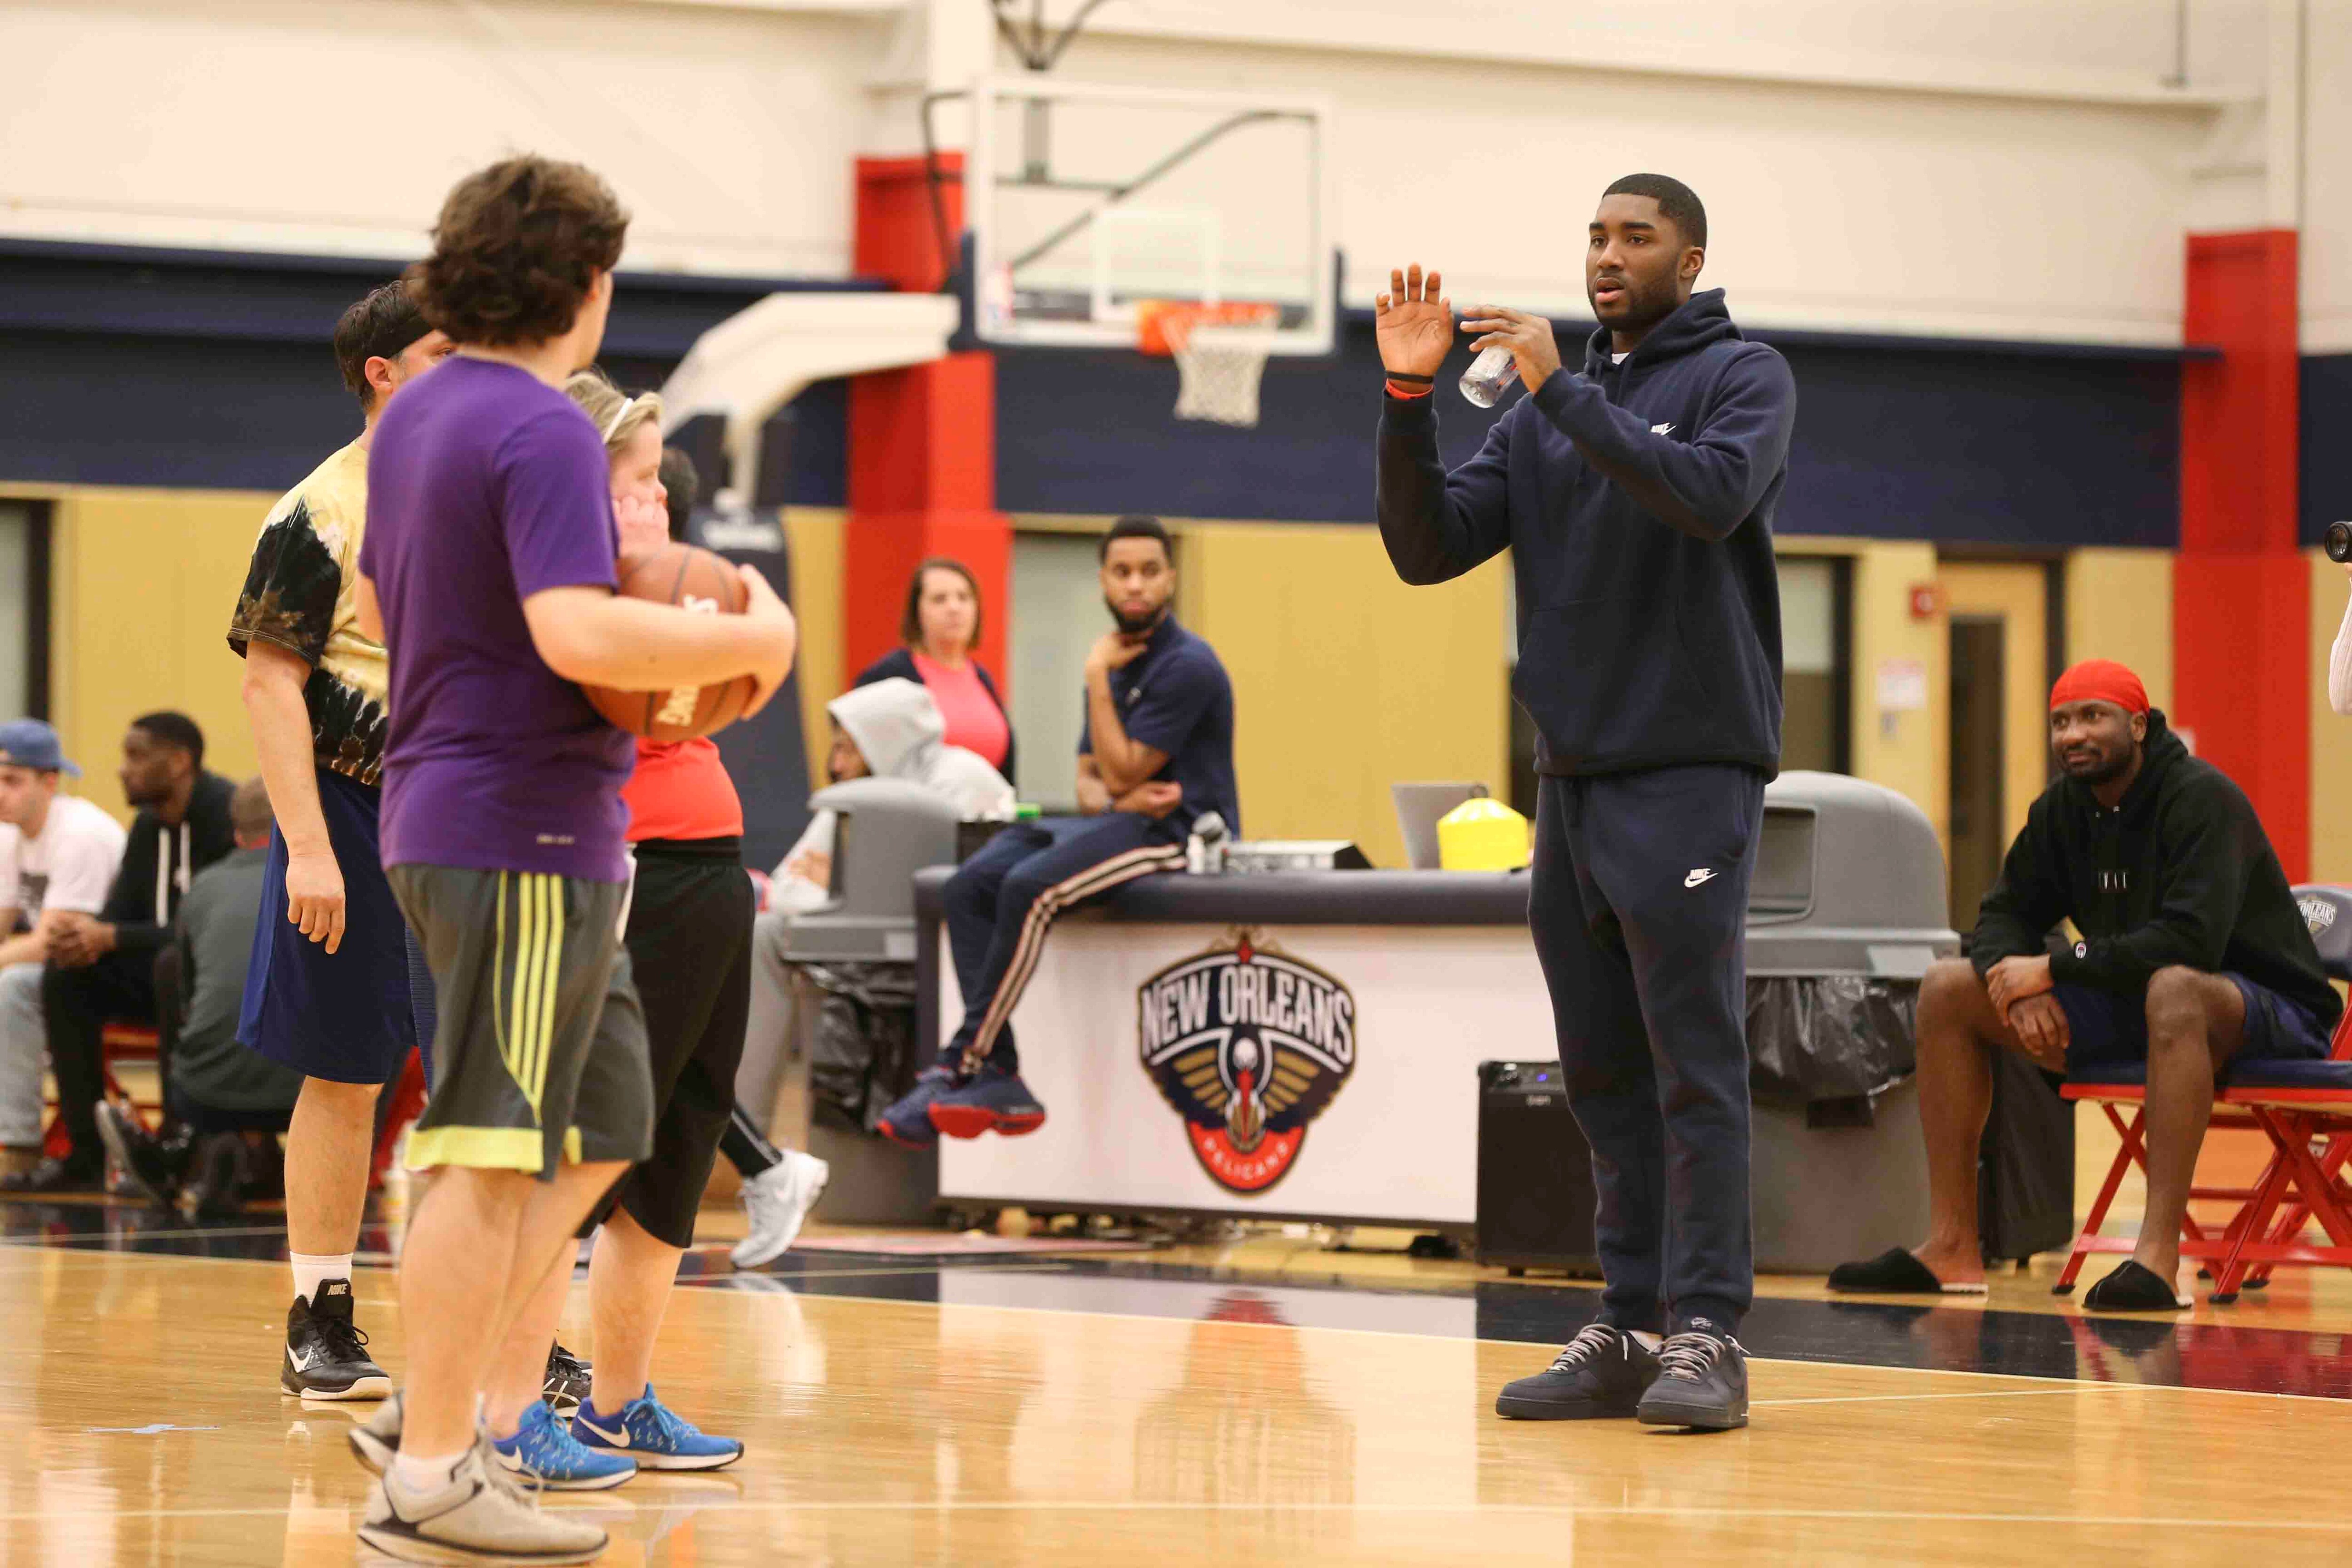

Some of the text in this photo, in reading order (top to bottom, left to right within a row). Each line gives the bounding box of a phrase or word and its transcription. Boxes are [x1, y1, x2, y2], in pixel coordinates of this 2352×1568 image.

[1689, 868, 1711, 880] NIKE
[1142, 964, 1354, 1064] NEW ORLEANS
[327, 1283, 348, 1296] NIKE
